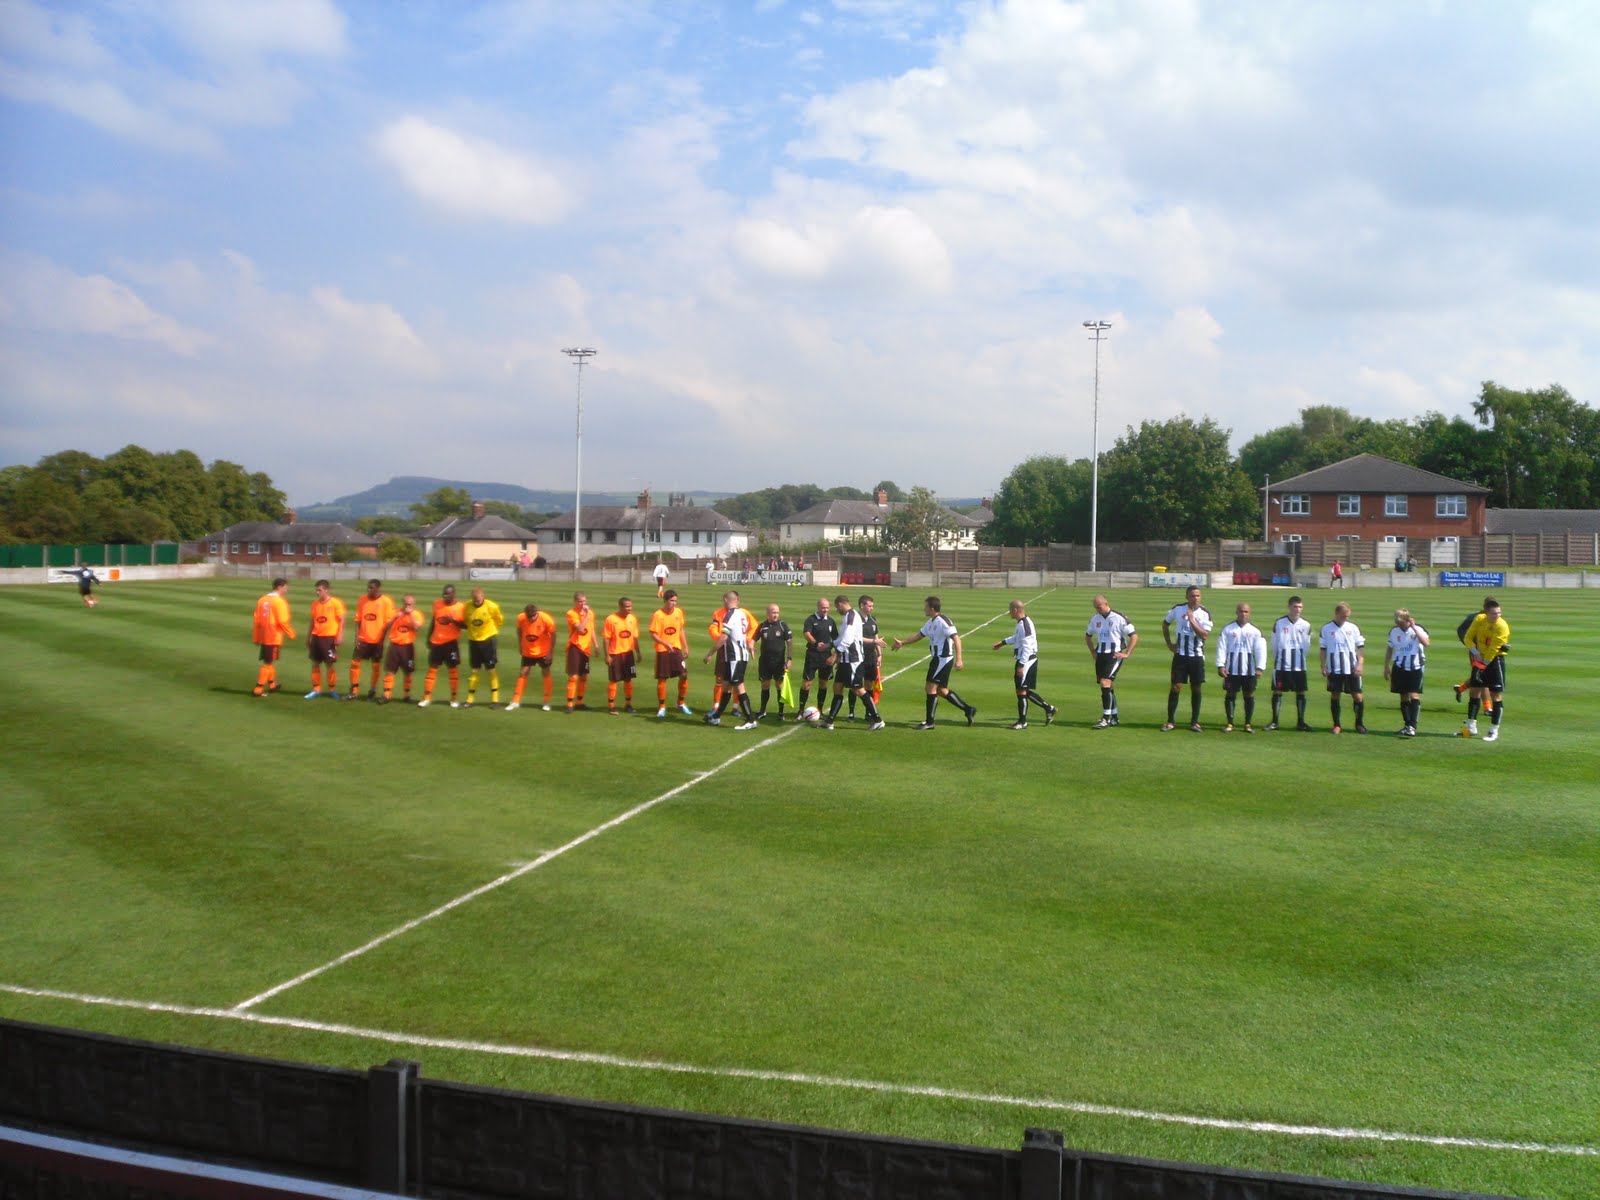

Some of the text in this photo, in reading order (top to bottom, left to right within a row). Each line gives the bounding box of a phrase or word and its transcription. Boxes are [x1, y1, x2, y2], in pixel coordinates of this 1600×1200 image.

[710, 571, 804, 581] Conglen Chronicle
[740, 618, 747, 634] 5
